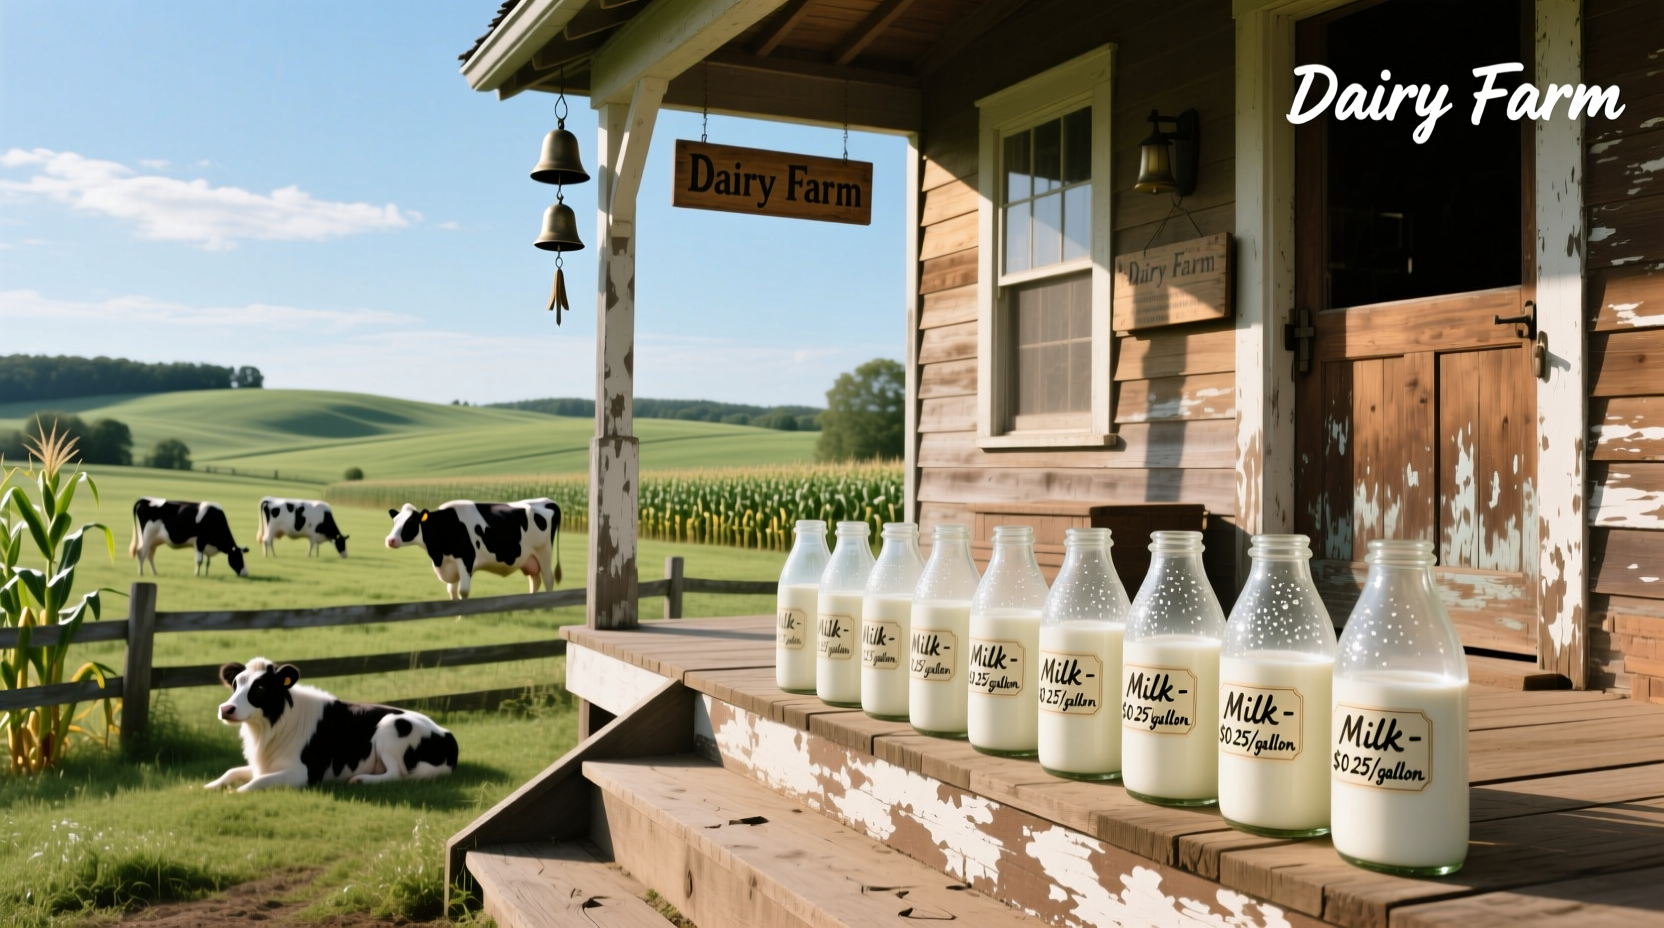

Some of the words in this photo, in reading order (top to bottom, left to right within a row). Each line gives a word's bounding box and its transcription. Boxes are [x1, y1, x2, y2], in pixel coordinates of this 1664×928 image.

[688, 153, 776, 208] Dairy
[785, 164, 861, 208] Farm
[1172, 251, 1215, 278] Farm
